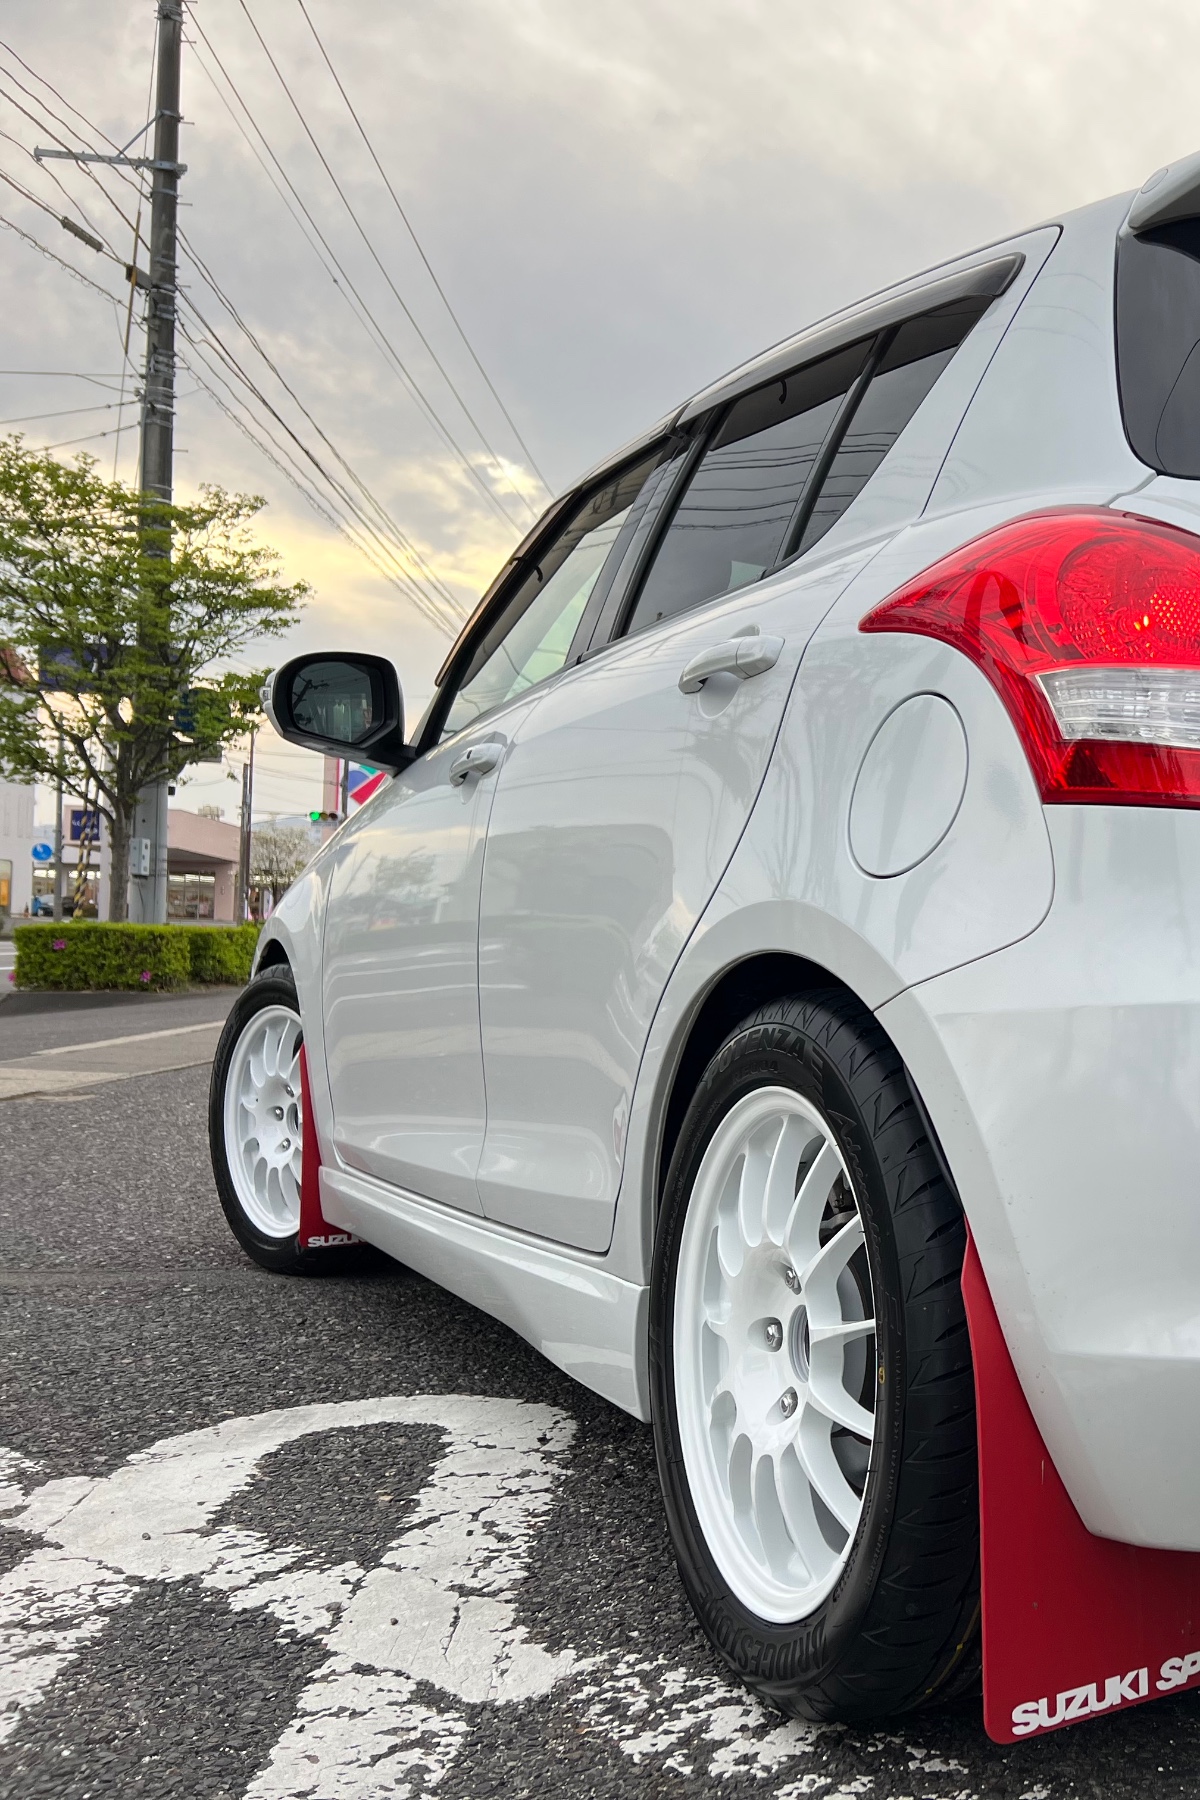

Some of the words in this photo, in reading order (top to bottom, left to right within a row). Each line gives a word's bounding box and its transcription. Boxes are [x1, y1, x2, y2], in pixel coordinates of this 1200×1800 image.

[706, 1027, 806, 1091] POTENZA
[307, 1233, 362, 1248] SUZU
[698, 1582, 827, 1682] BRIDGESTONE
[1011, 1666, 1149, 1736] SUZUKI
